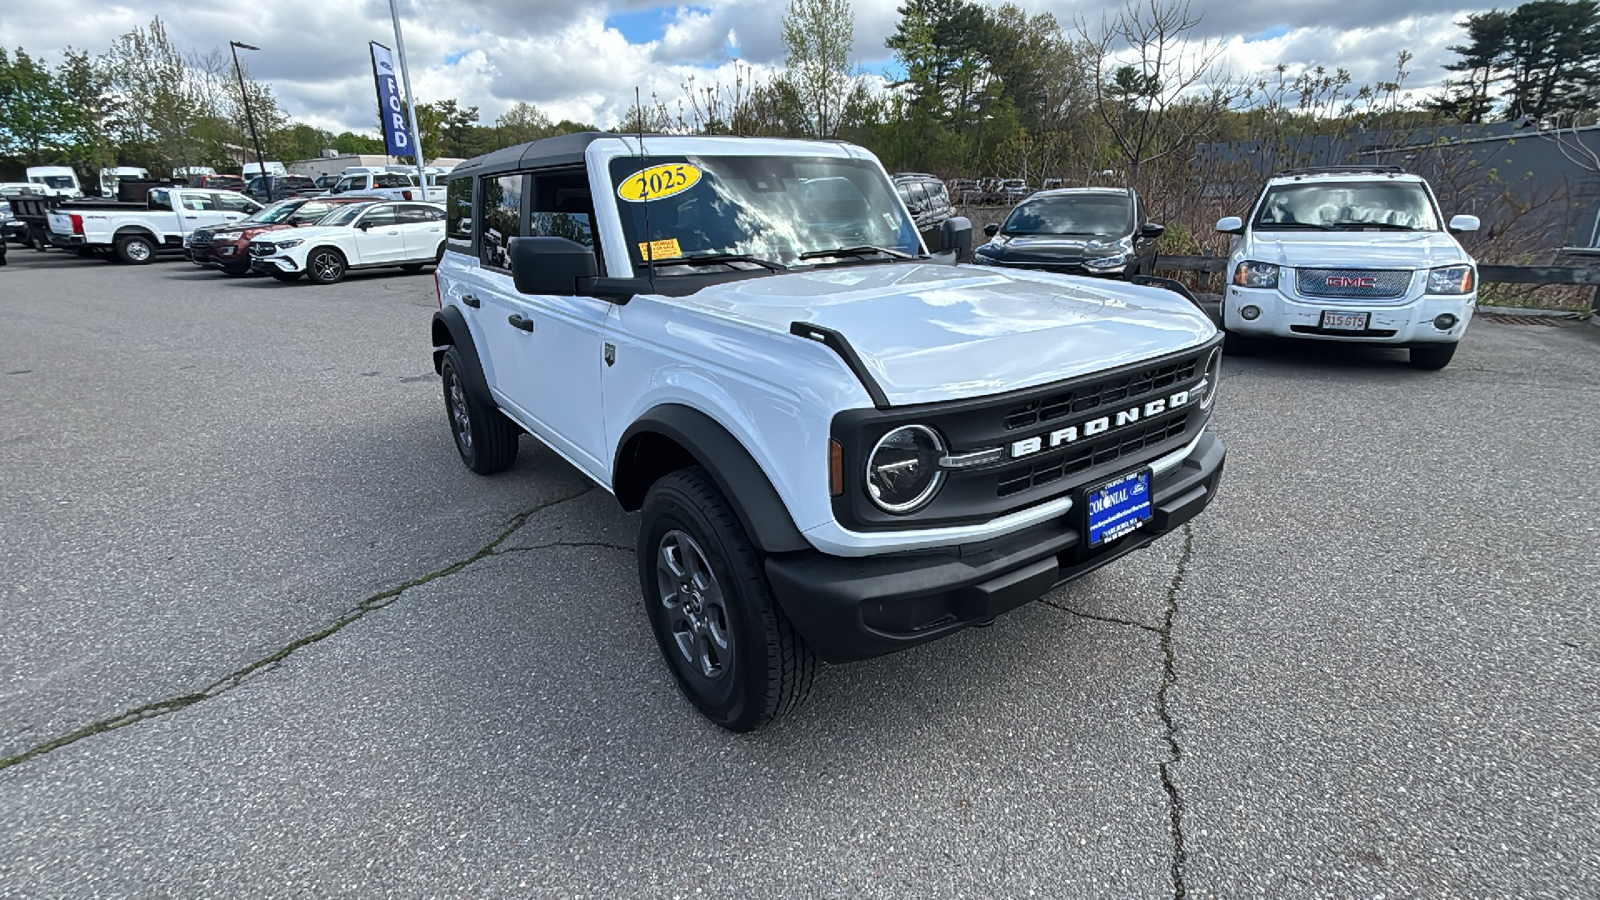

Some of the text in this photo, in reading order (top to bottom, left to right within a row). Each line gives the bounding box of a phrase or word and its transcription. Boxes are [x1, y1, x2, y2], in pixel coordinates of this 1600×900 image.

[387, 77, 408, 148] FORD
[636, 167, 686, 198] 2025
[1326, 276, 1377, 288] GMC
[1324, 316, 1344, 326] 315
[1011, 391, 1188, 458] BRONCO
[1089, 488, 1129, 516] COLONIAL
